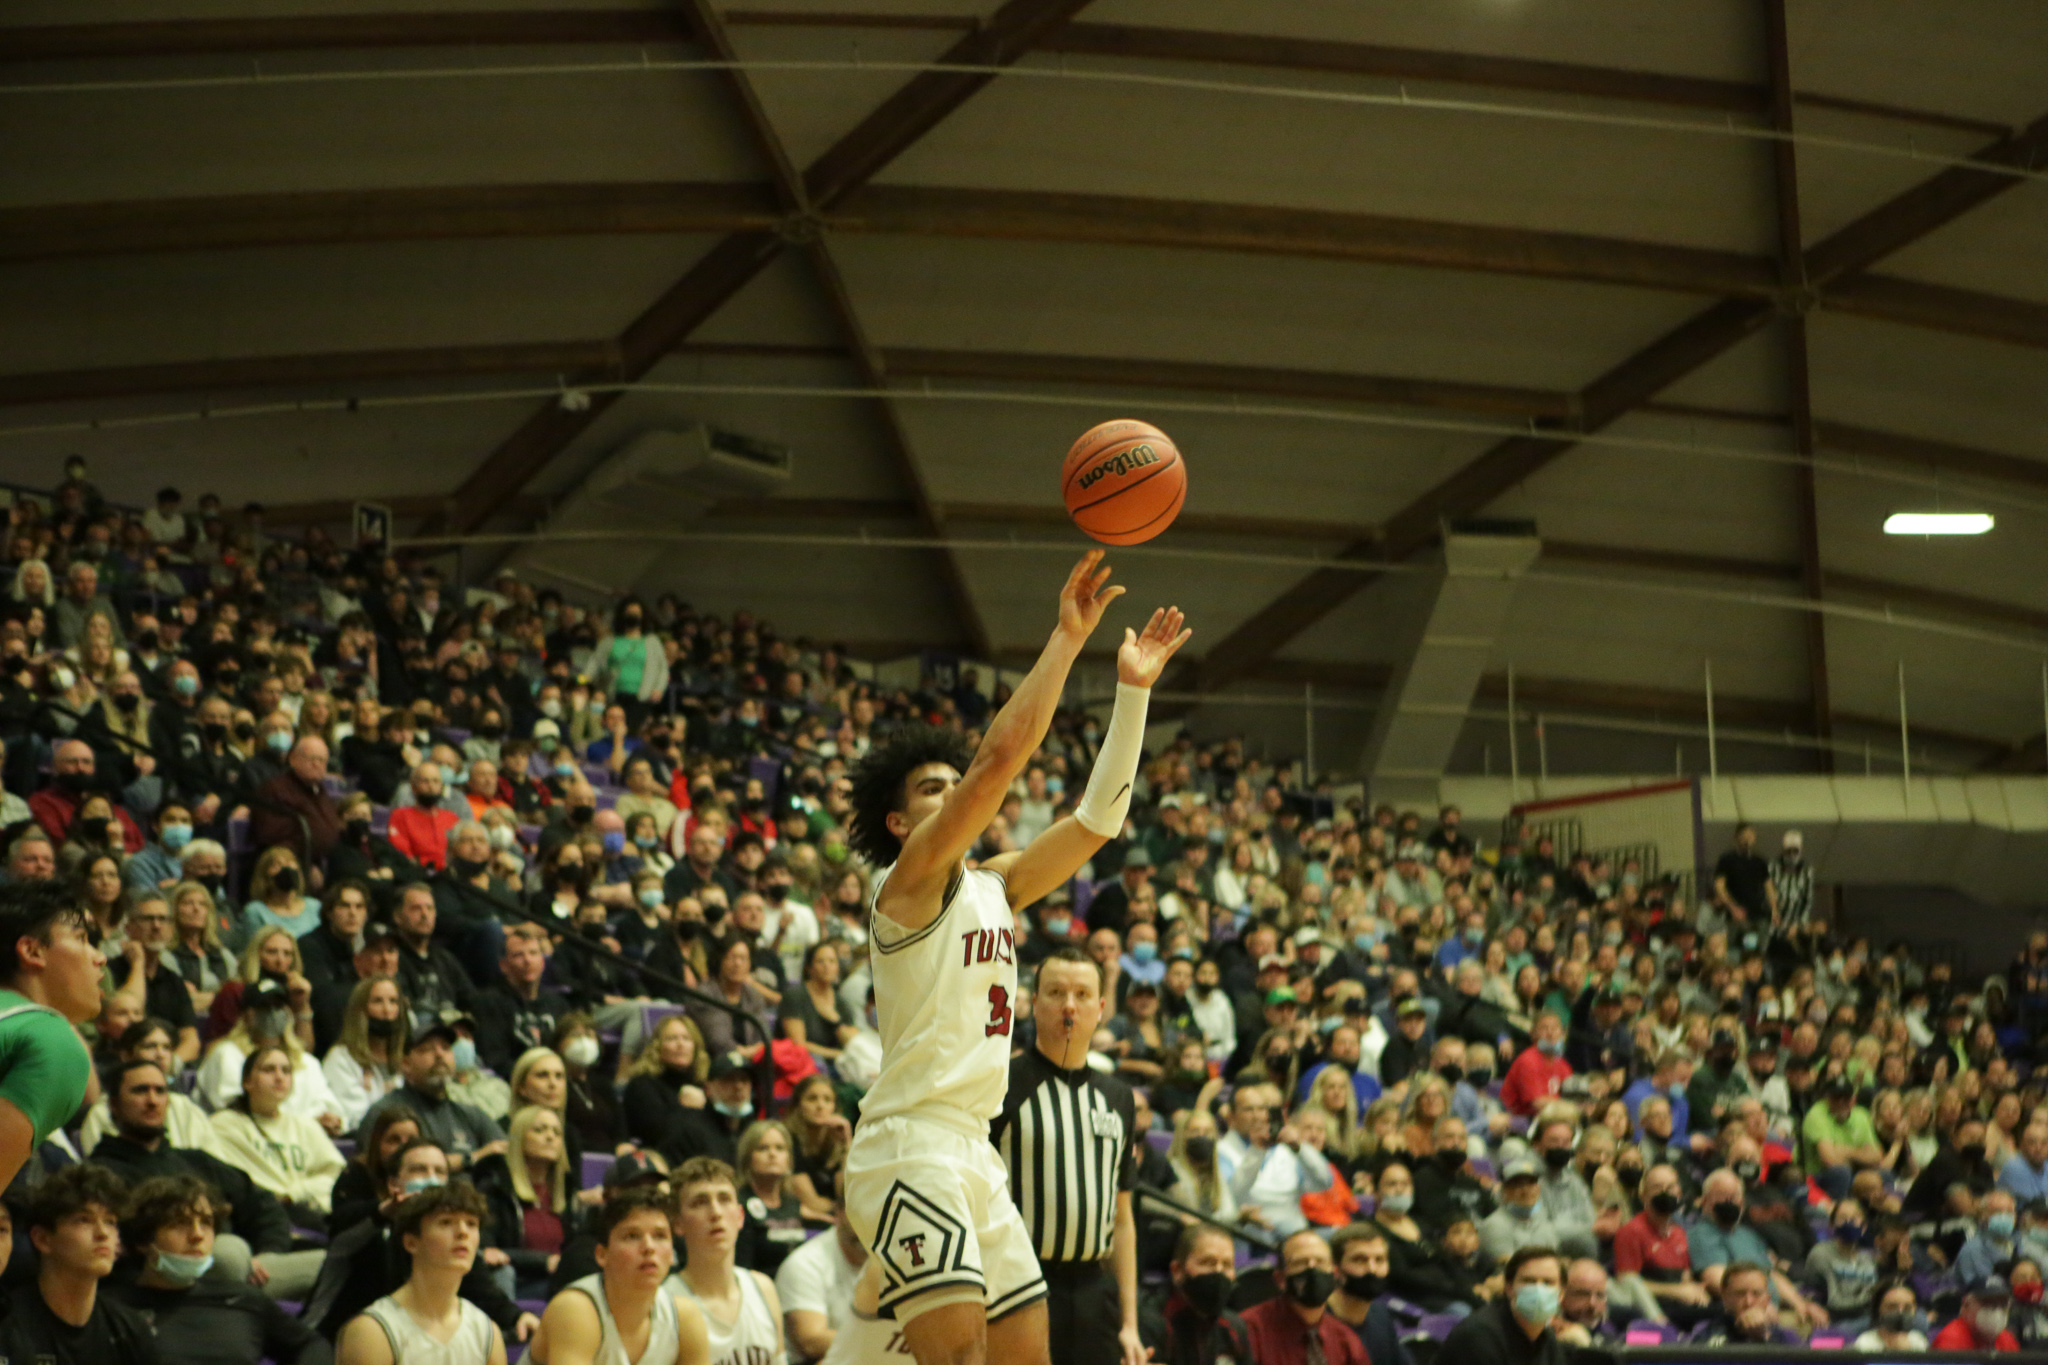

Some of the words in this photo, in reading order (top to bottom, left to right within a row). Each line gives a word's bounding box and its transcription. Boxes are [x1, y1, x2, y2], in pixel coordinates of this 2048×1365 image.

[1078, 444, 1160, 490] Wilson
[985, 983, 1010, 1037] 3
[899, 1231, 926, 1267] T
